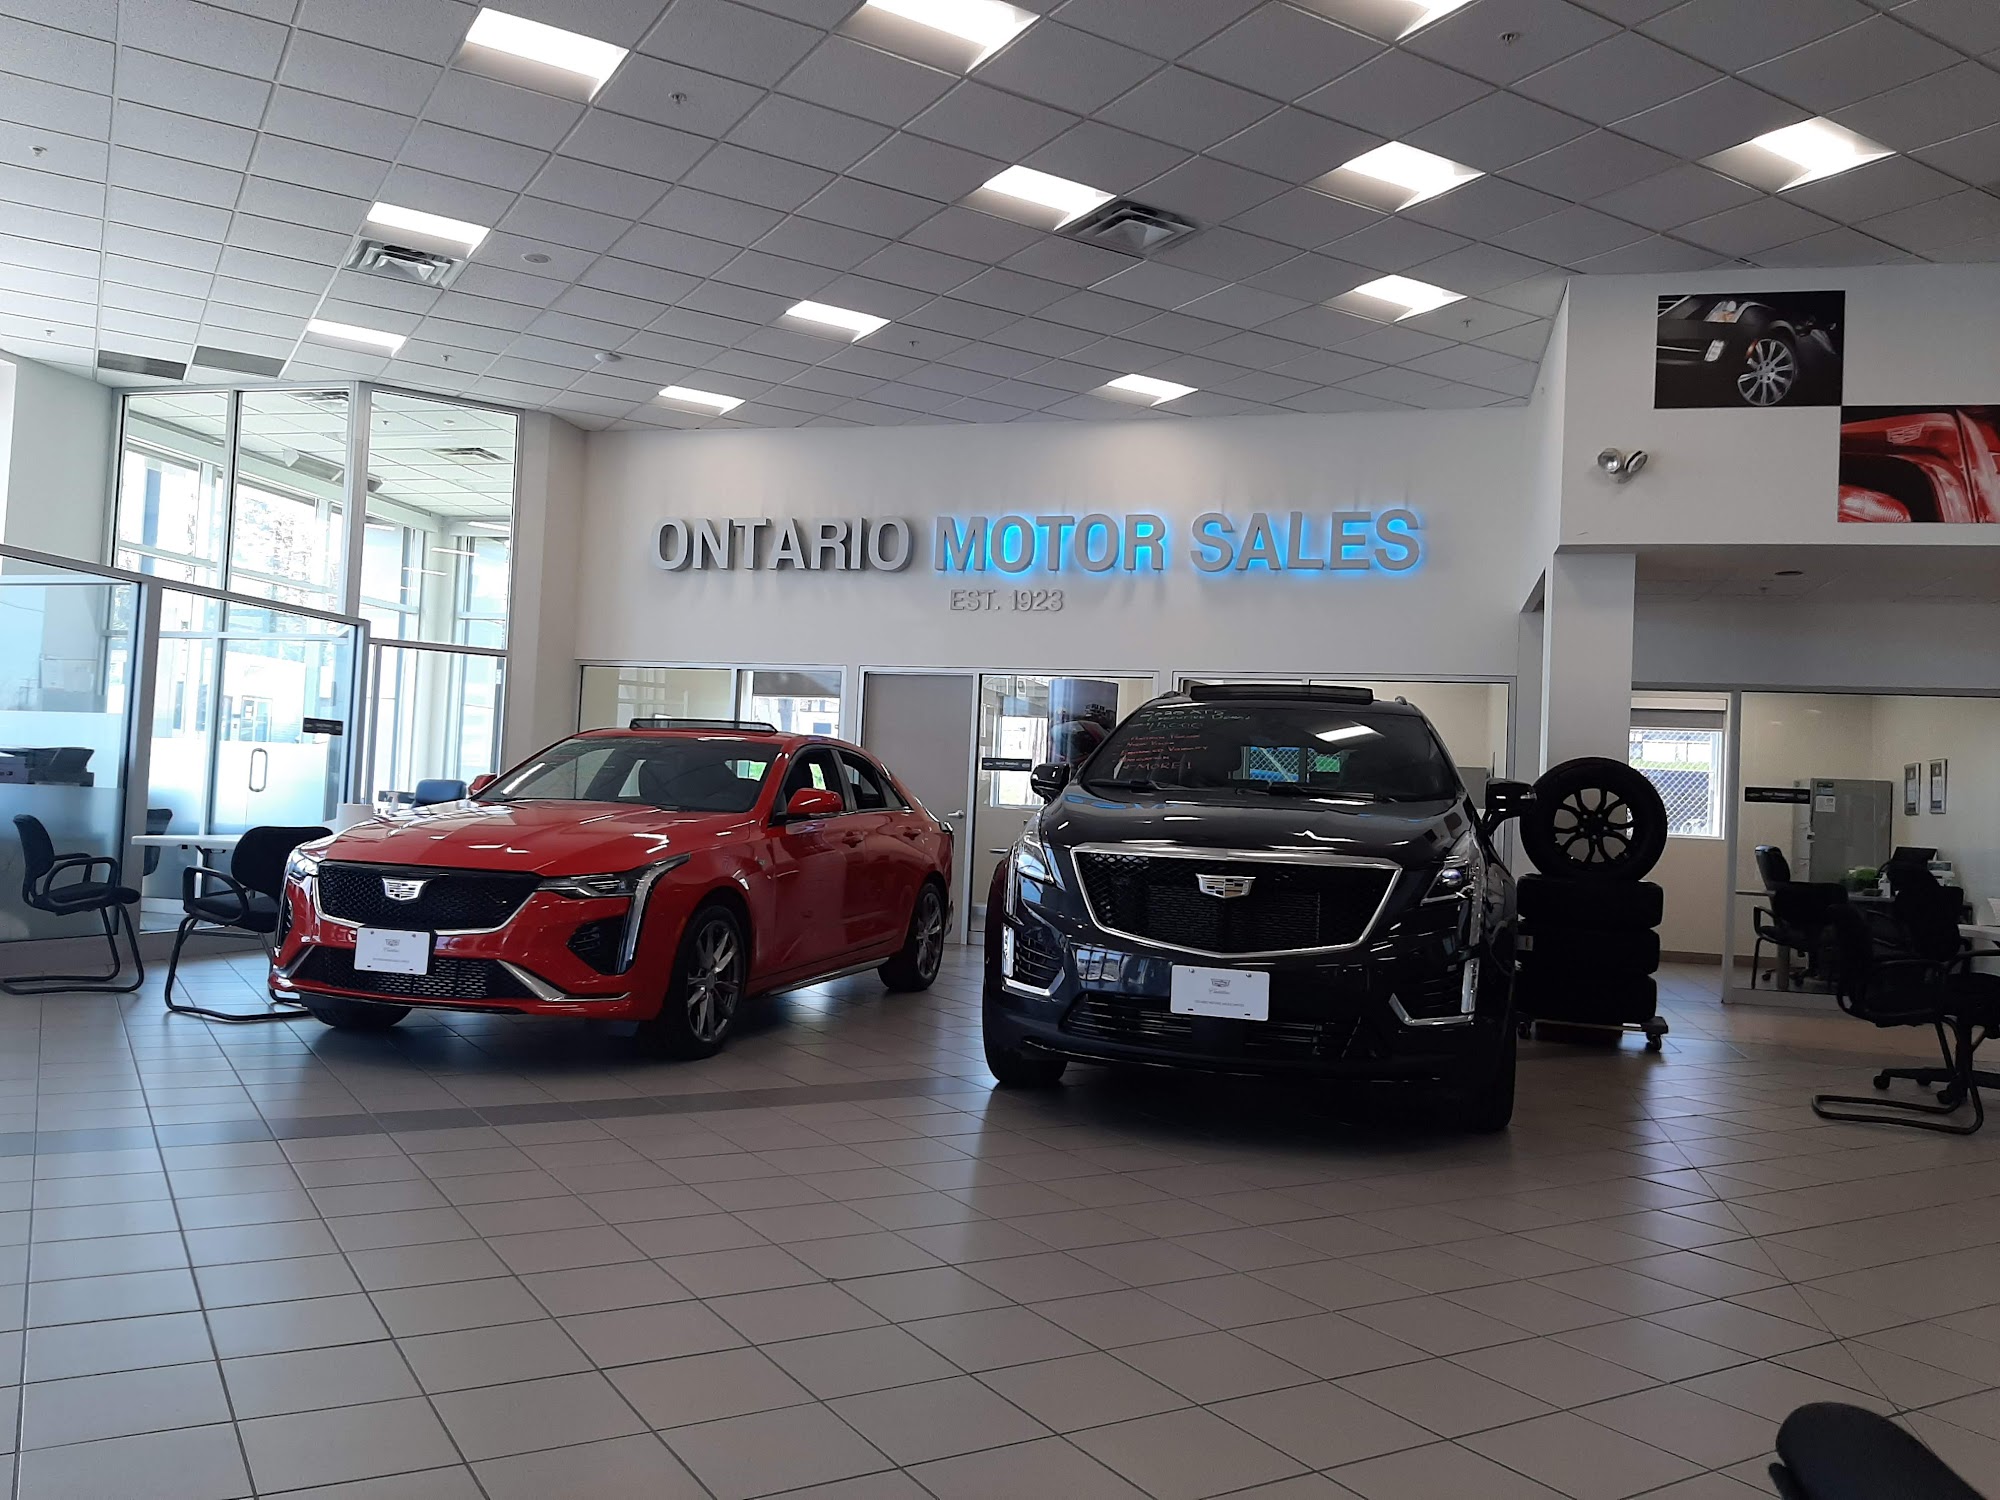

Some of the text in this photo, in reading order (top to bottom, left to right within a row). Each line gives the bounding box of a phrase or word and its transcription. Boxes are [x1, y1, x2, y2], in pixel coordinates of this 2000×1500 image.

[651, 509, 1421, 573] ONTARIO MOTOR SALES
[950, 589, 1064, 612] EST. 1923
